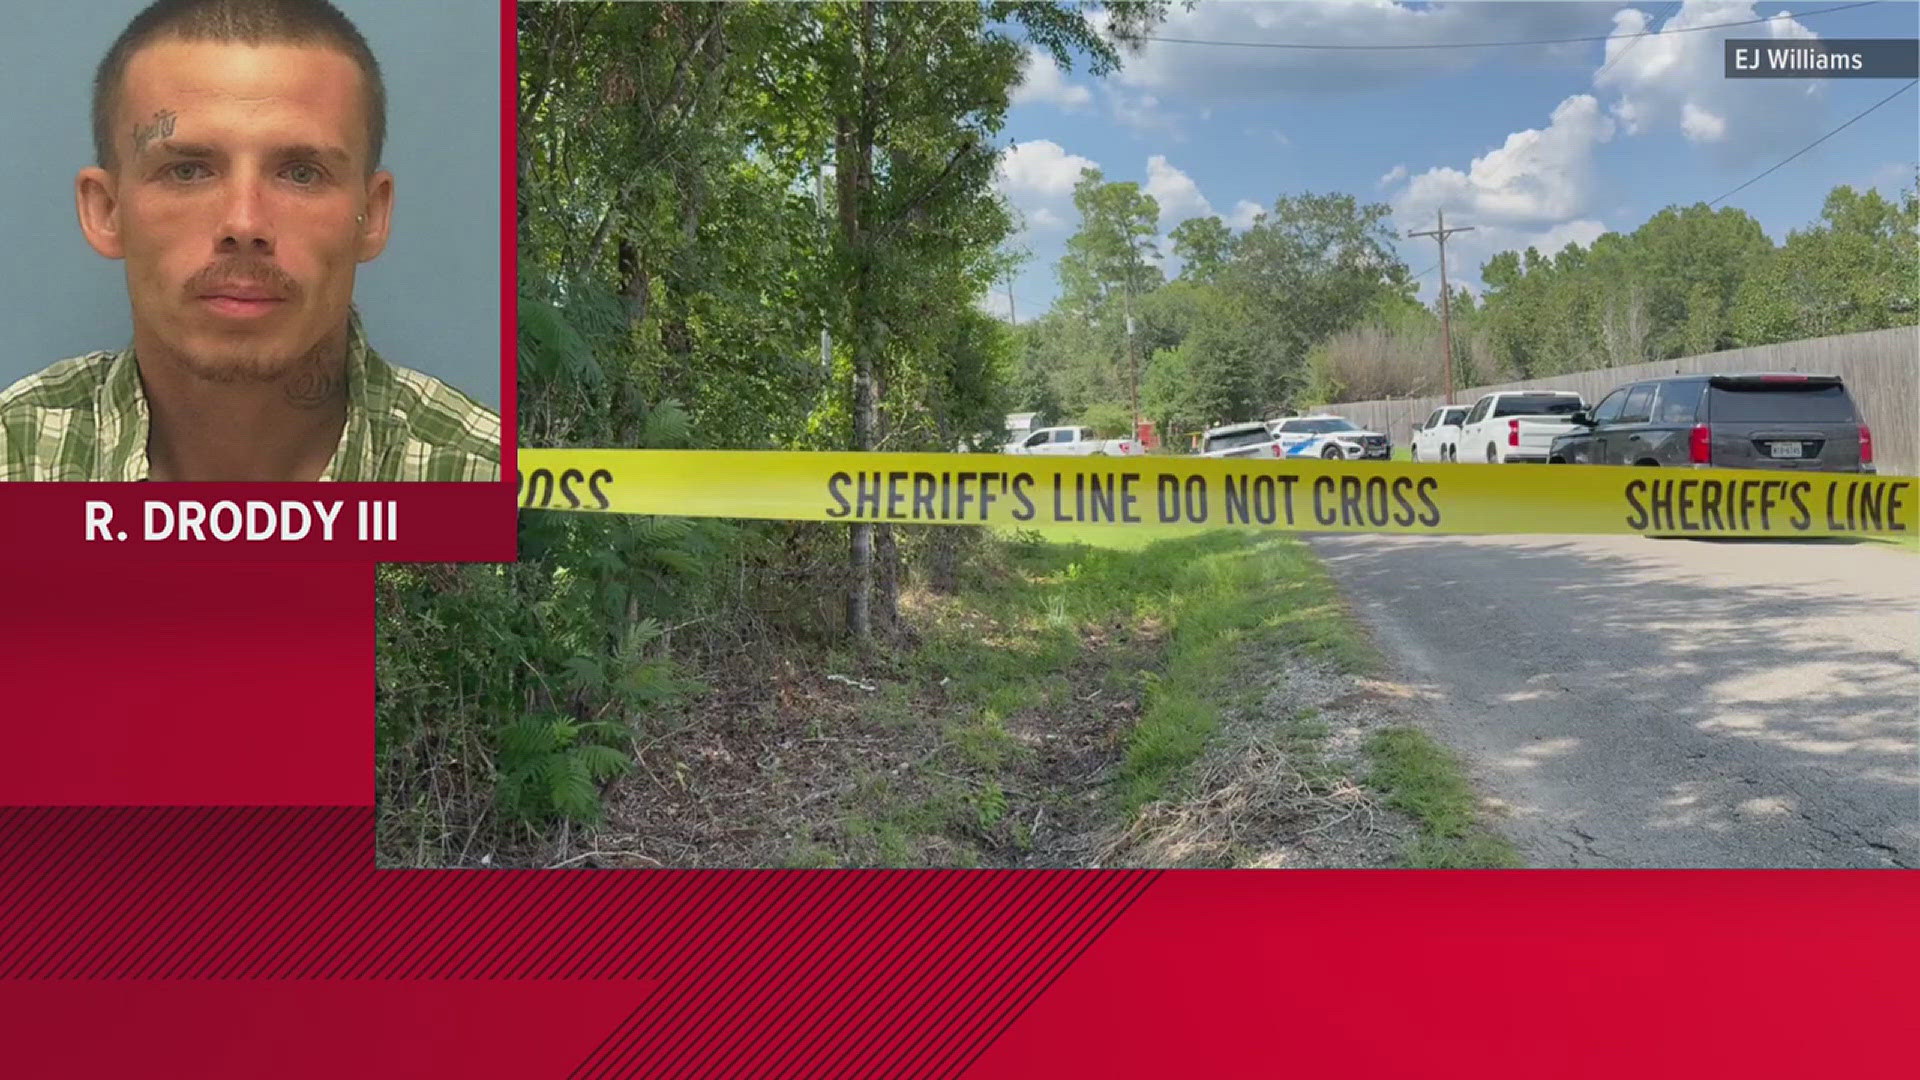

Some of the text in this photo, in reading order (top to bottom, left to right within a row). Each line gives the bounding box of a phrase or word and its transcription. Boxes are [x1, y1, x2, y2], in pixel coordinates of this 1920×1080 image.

[518, 469, 613, 510] OSS
[826, 471, 1440, 527] SHERIFF'S LINE DO NOT CROSS
[1625, 479, 1910, 531] SHERIFF'S LINE
